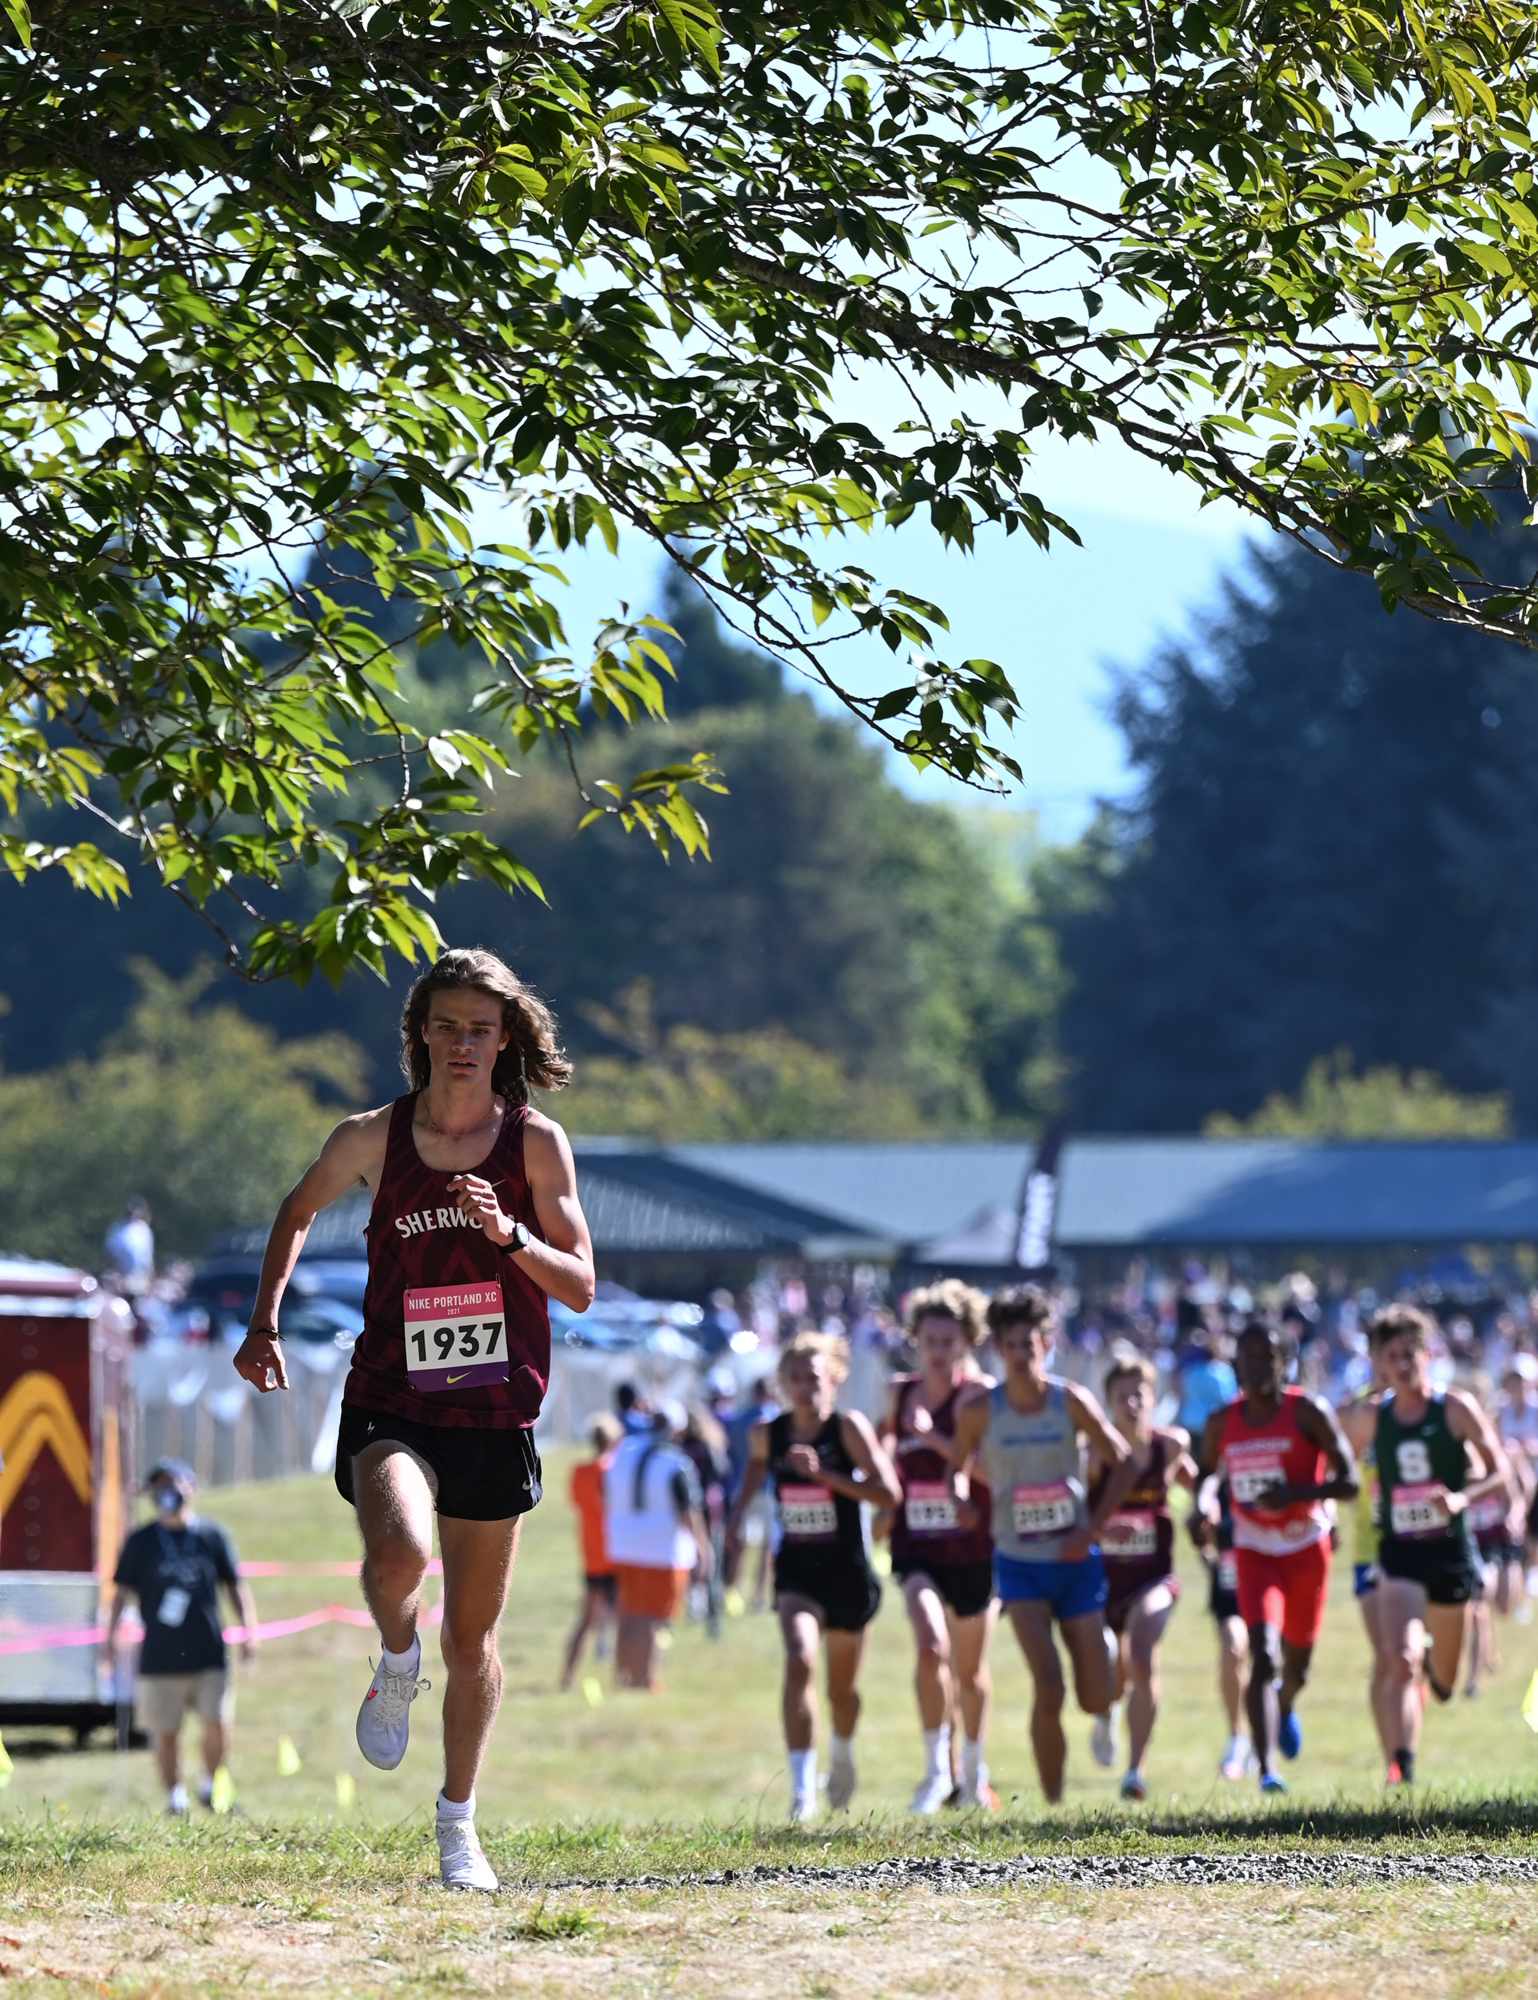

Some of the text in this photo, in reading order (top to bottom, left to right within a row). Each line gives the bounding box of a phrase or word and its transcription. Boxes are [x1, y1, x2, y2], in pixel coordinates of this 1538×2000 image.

[394, 1207, 484, 1239] SHERW
[408, 1291, 497, 1310] NIKE PORTLAND XC
[411, 1322, 503, 1362] 1937
[1397, 1440, 1431, 1483] S
